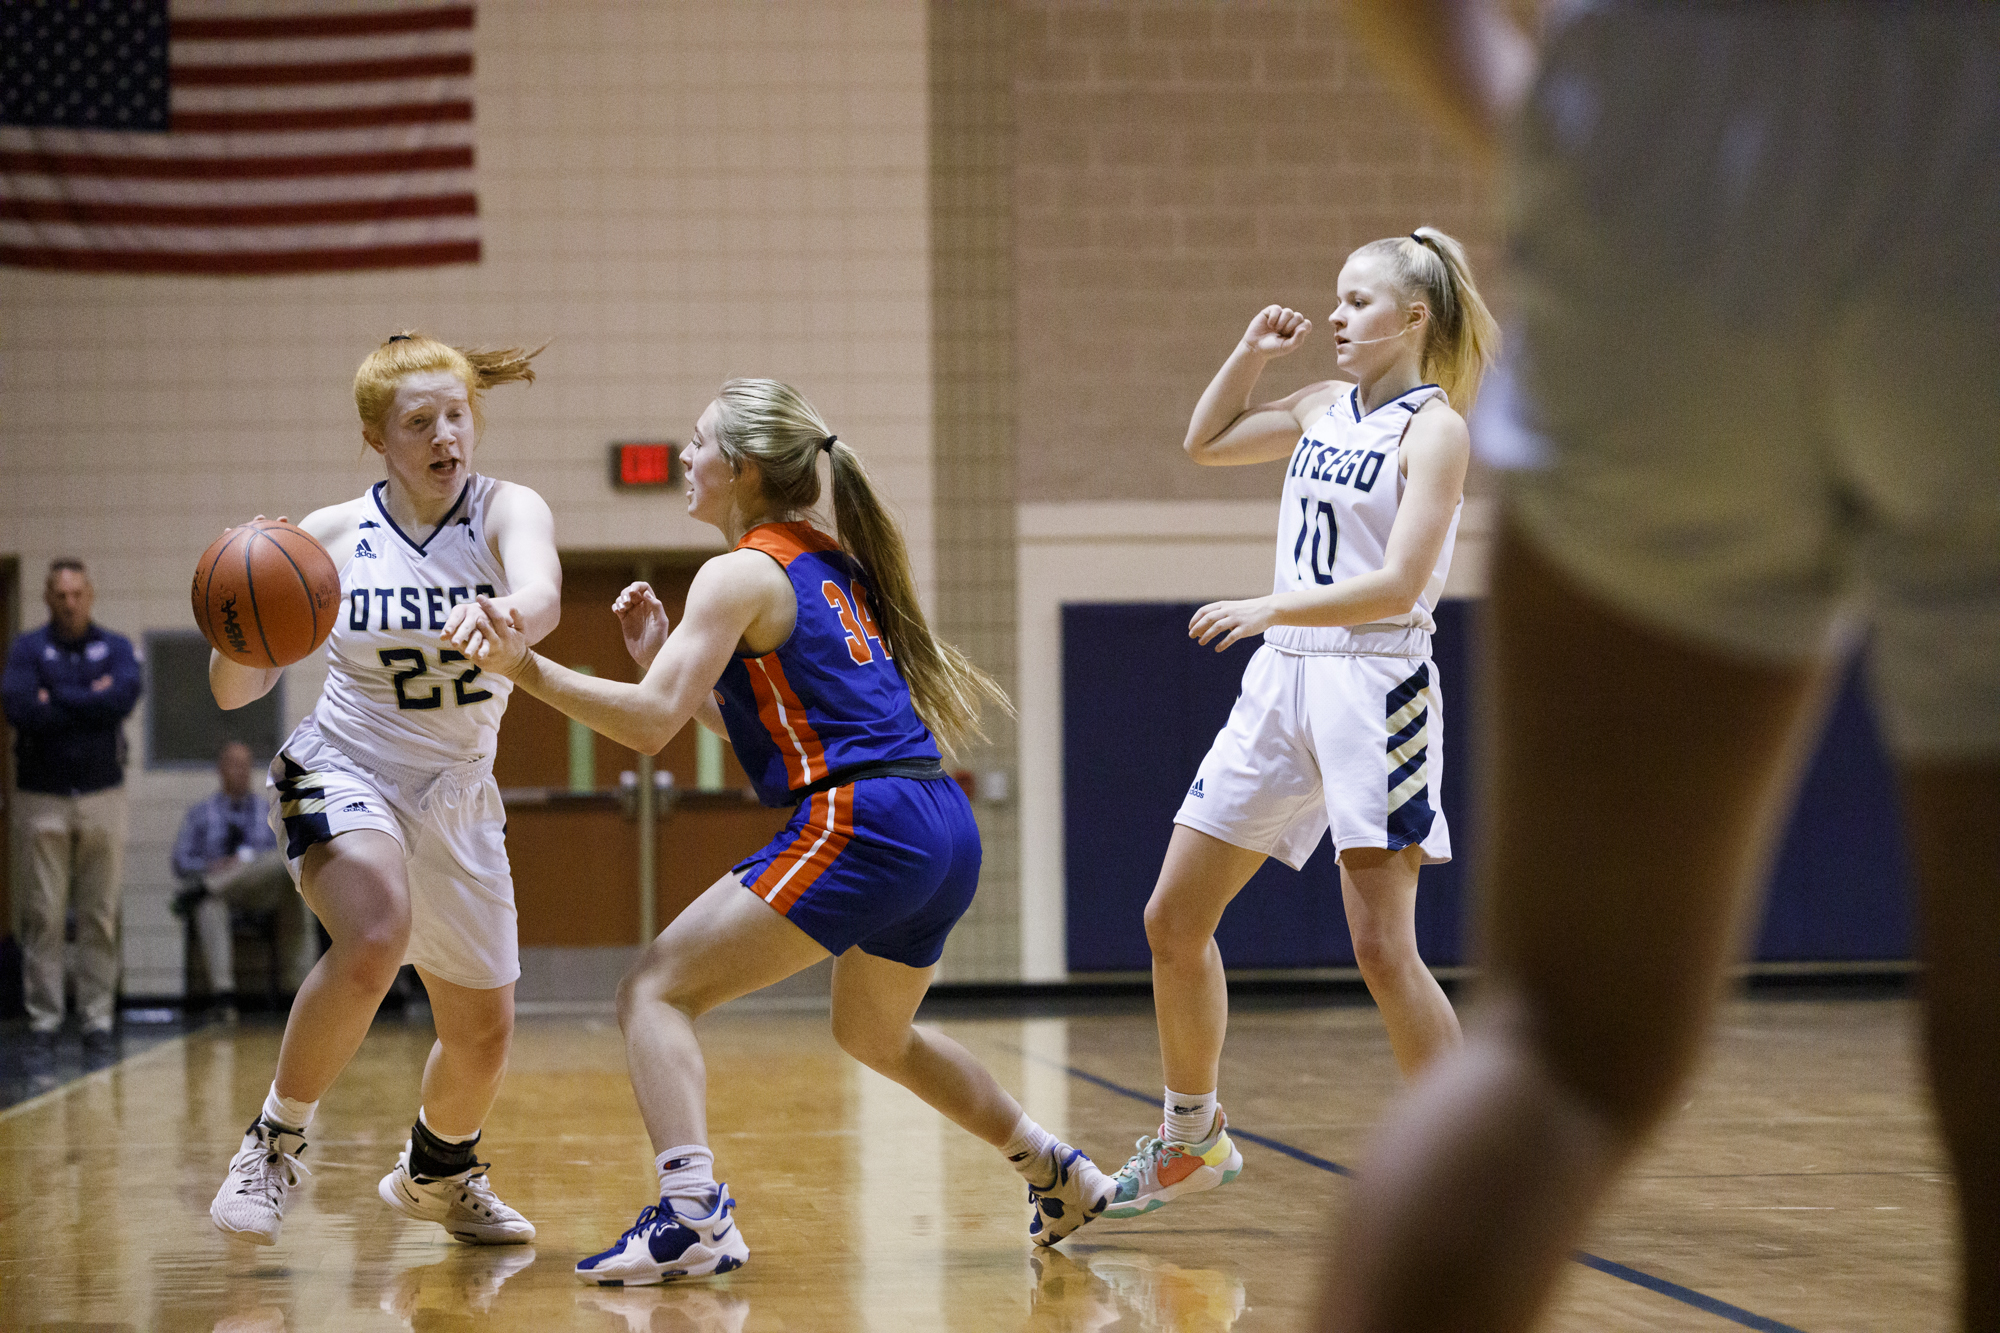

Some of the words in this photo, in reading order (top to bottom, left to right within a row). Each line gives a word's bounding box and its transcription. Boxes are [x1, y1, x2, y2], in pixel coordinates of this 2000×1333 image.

[1294, 497, 1339, 586] 10
[350, 584, 496, 631] OTSE
[822, 580, 892, 666] 34
[377, 648, 494, 709] 22
